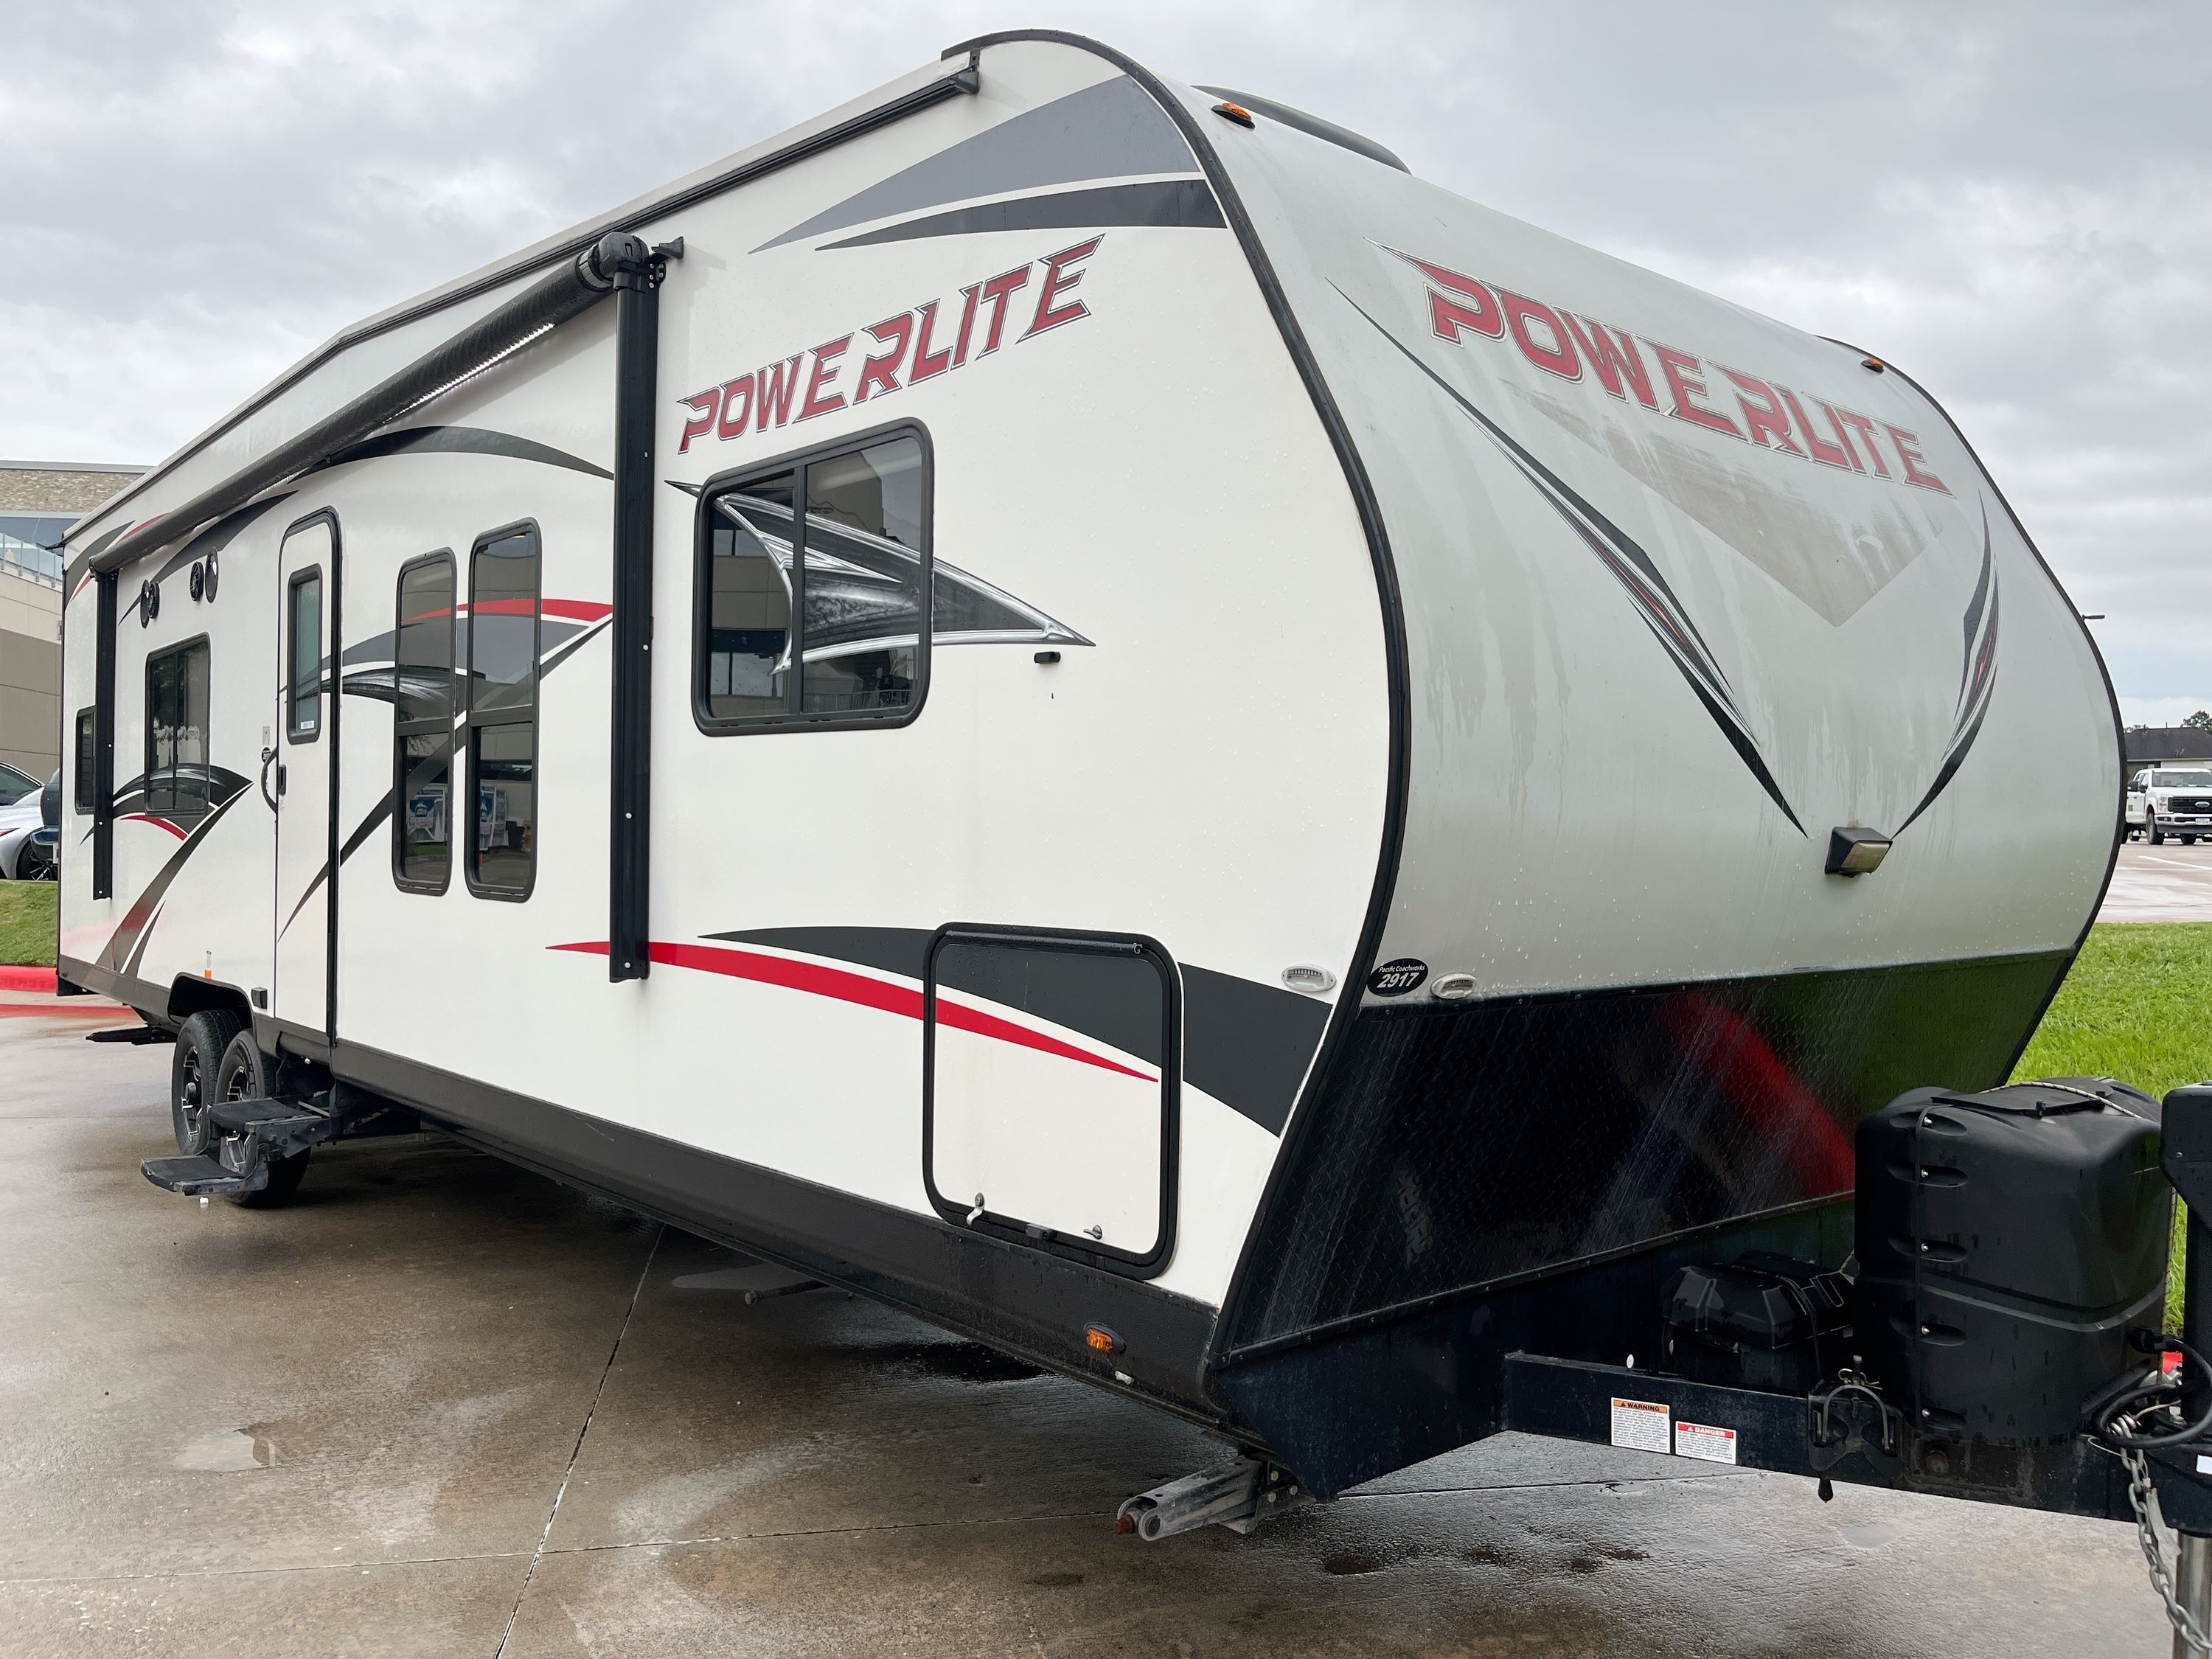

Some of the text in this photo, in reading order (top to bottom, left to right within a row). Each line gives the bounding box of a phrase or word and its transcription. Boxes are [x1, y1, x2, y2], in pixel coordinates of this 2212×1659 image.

[678, 233, 1106, 455] POWERLITE
[1363, 237, 1957, 498] POWERLITE
[1377, 972, 1420, 988] 2917
[1627, 1402, 1660, 1411] WARNING
[1694, 1427, 1725, 1436] DANGER
